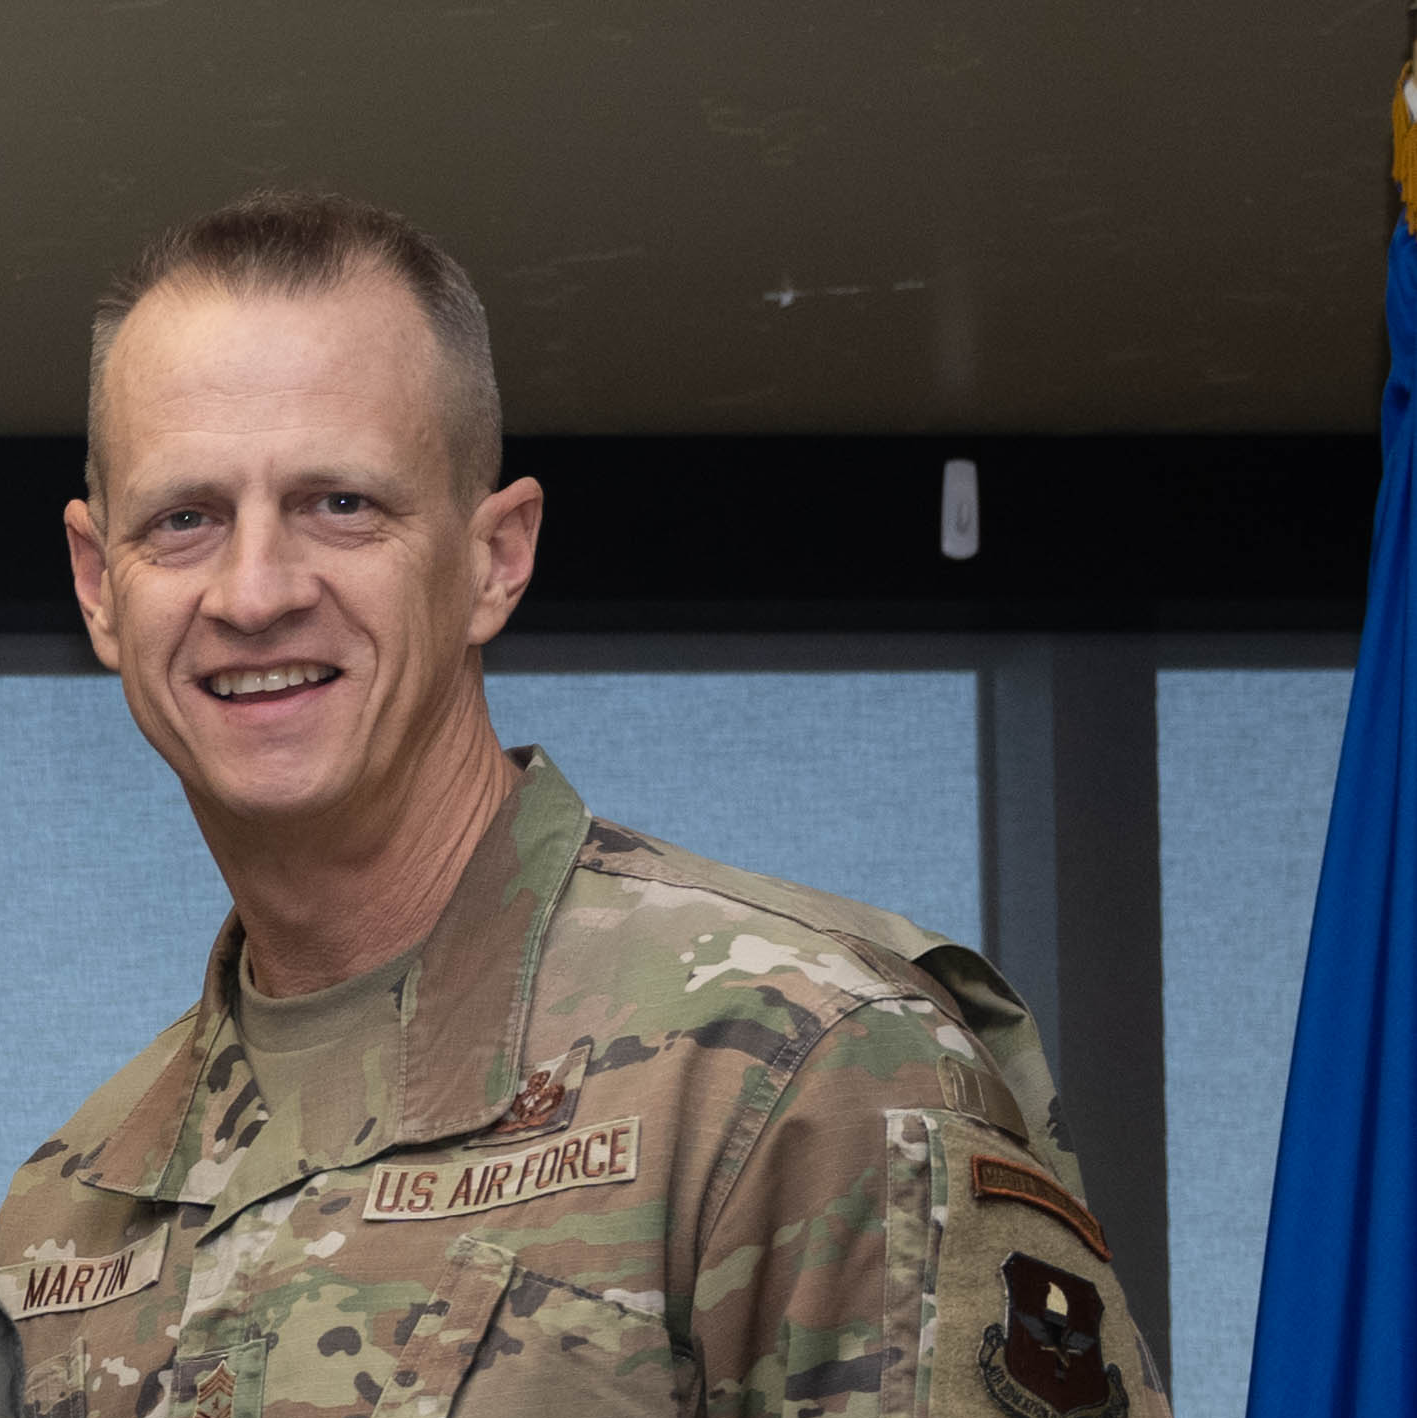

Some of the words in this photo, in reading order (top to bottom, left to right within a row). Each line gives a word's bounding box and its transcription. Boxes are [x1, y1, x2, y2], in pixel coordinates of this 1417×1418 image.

[374, 1171, 438, 1213] U.S.
[447, 1161, 513, 1209] AIR
[515, 1126, 631, 1197] FORCE
[22, 1249, 135, 1311] MARTIN
